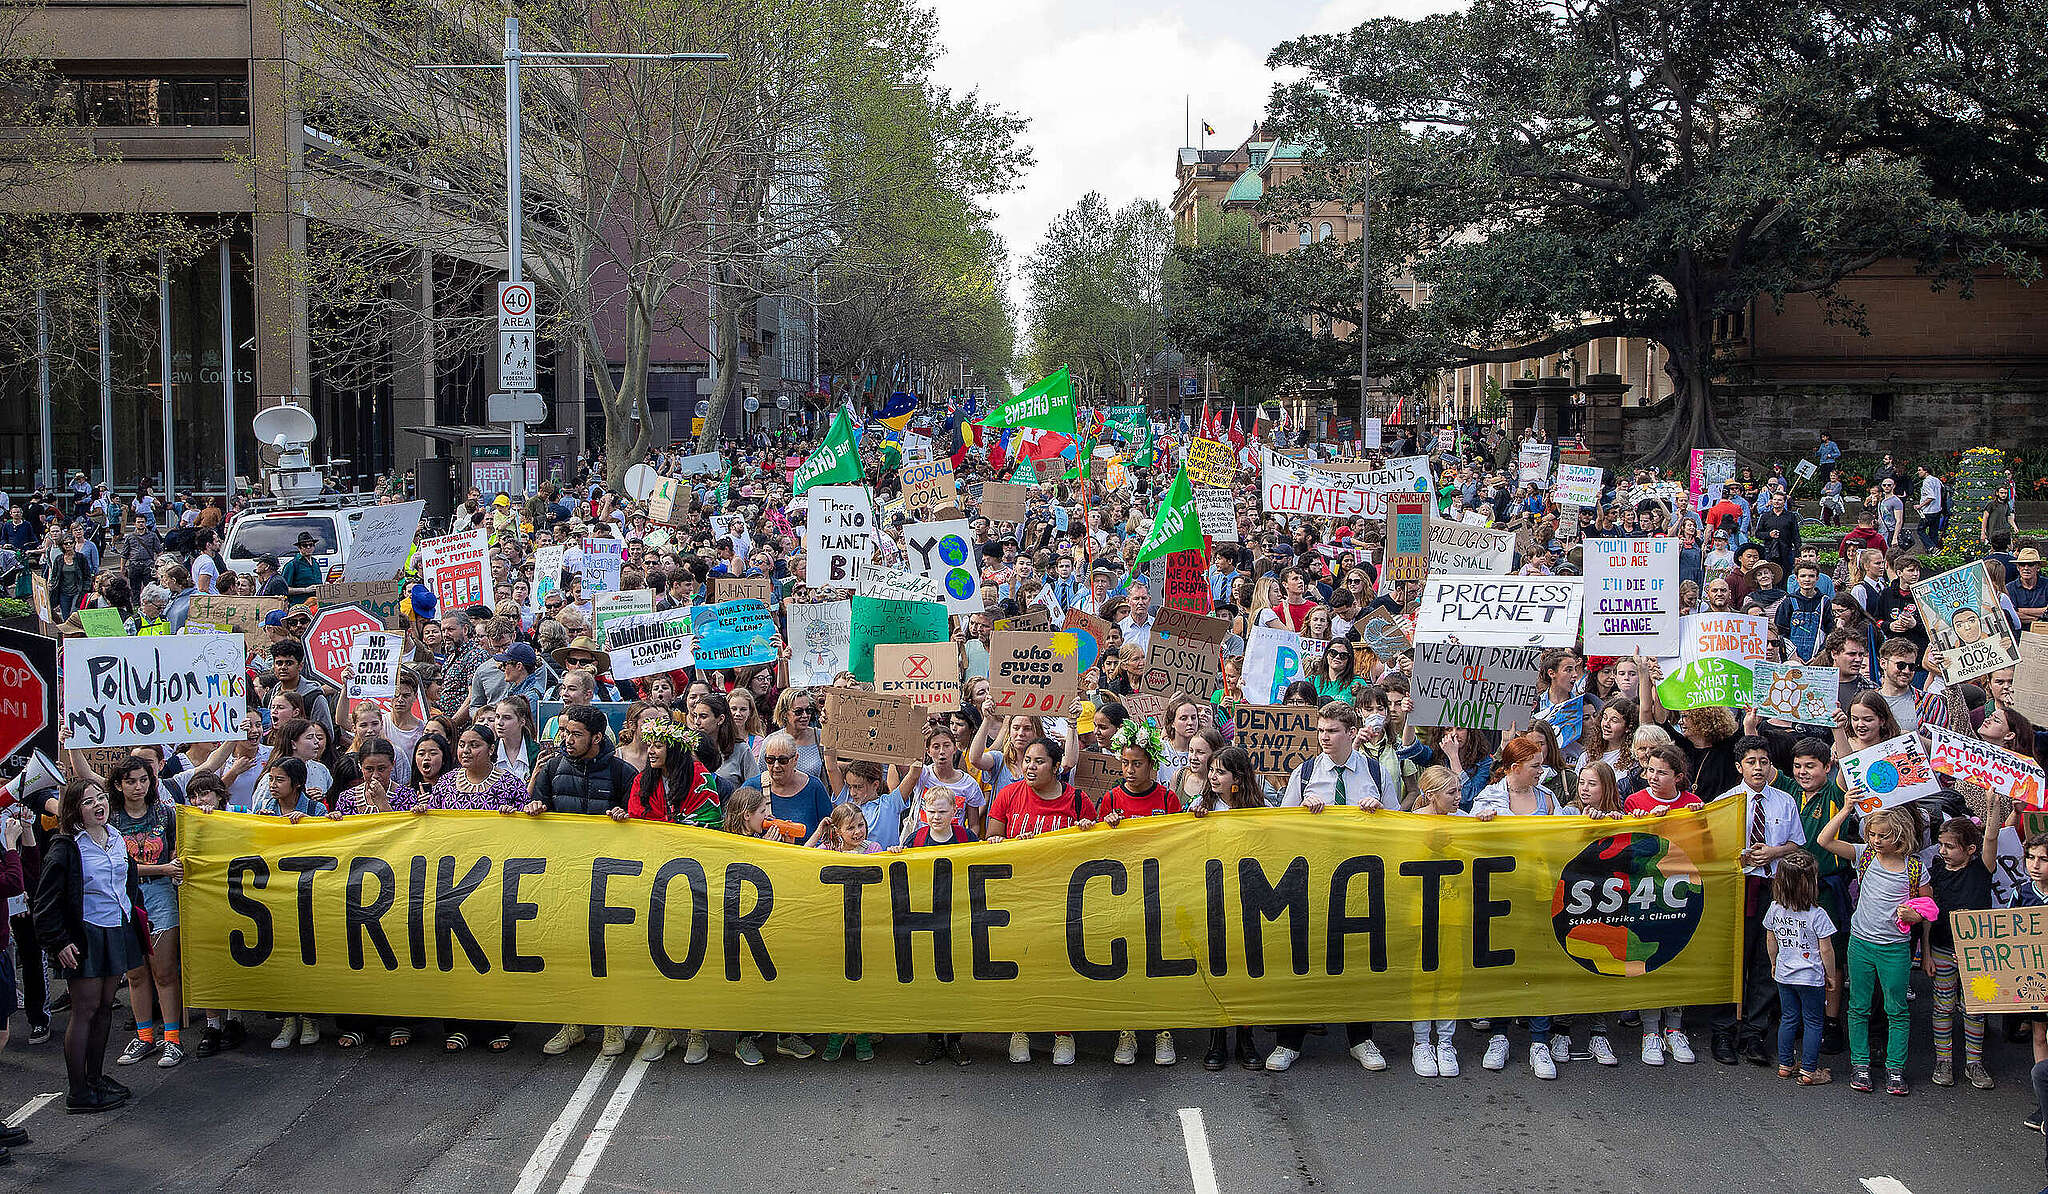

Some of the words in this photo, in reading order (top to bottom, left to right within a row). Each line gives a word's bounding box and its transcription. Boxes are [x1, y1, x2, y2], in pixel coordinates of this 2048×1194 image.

[505, 294, 527, 307] 40
[502, 318, 532, 327] AREA
[475, 468, 505, 480] BEER
[903, 462, 953, 485] CORAL
[1346, 465, 1415, 485] STUDENTS
[1568, 466, 1596, 476] STAND
[915, 480, 937, 490] NOT
[818, 498, 855, 512] There
[910, 487, 949, 507] COAL
[1270, 484, 1348, 515] CLIMATE
[1388, 494, 1398, 502] AS
[1568, 493, 1596, 504] SCIENCE
[840, 512, 865, 527] NO
[441, 531, 478, 544] GAMBLING
[822, 534, 870, 550] PLANET
[434, 545, 456, 554] WITH
[456, 542, 472, 550] OUR
[584, 538, 621, 554] Human
[1634, 542, 1650, 554] DIE
[1654, 541, 1668, 553] OF
[450, 549, 484, 562] FUTURE
[1453, 554, 1492, 571] SMALL
[1609, 556, 1628, 566] OLD
[1630, 556, 1648, 566] AGE
[586, 569, 607, 580] NOT
[863, 566, 886, 582] The
[1932, 572, 1967, 592] REAL
[319, 584, 340, 600] THIS
[348, 584, 358, 597] IS
[366, 582, 393, 597] WHAT
[718, 583, 752, 598] WHAT
[756, 585, 766, 600] I
[1626, 578, 1646, 591] DIE
[1651, 578, 1664, 592] OF
[1935, 582, 1970, 598] CLIMATE
[1437, 583, 1572, 604] PRICELESS
[1941, 590, 1970, 604] ACTION
[876, 600, 930, 615] PLANTS
[1600, 598, 1658, 612] CLIMATE
[886, 616, 912, 624] OVER
[1442, 604, 1566, 623] PLANET
[718, 618, 738, 628] KEEP
[854, 622, 888, 638] POWER
[1014, 619, 1031, 628] THE
[1604, 618, 1652, 632] CHANGE
[1700, 620, 1744, 634] WHAT
[1748, 620, 1758, 637] I
[370, 636, 386, 648] NO
[630, 638, 682, 659] LOADING
[1177, 630, 1200, 648] BE
[1202, 636, 1214, 655] A
[1698, 635, 1740, 654] STAND
[1740, 638, 1764, 654] FOR
[1960, 644, 1971, 654] WE
[1970, 641, 1986, 651] NEED
[362, 649, 390, 661] NEW
[632, 656, 656, 667] PLEASE
[660, 652, 678, 660] WAIT
[696, 644, 753, 660] DOLPHINETLY!
[1012, 645, 1052, 660] who
[1422, 643, 1441, 665] WE
[1490, 649, 1542, 672] DRINK
[1958, 644, 1998, 668] 100%
[358, 662, 388, 674] COAL
[1150, 645, 1214, 676] FOSSIL
[1708, 658, 1724, 673] IS
[1958, 656, 2004, 677] RENEWABLES
[87, 647, 202, 706] Pollution
[1000, 662, 1050, 676] gives
[1052, 662, 1064, 672] a
[1463, 666, 1488, 682] OIL
[354, 676, 368, 685] OR
[370, 675, 388, 685] GAS
[882, 681, 958, 690] EXTINCTION
[1012, 674, 1052, 688] crap
[1174, 672, 1211, 700] FOOL
[1694, 674, 1729, 692] WHAT
[1732, 677, 1739, 688] I
[996, 690, 1016, 706] I
[1023, 692, 1065, 712] DO!
[1481, 682, 1537, 706] BREATHE
[1686, 689, 1726, 707] STAND
[1734, 690, 1752, 704] ON
[1236, 709, 1318, 732] DENIAL
[1438, 699, 1504, 730] MONEY
[1237, 732, 1258, 748] IS
[1261, 732, 1296, 751] NOT
[1298, 738, 1309, 752] A
[1249, 751, 1315, 772] OLICY
[1936, 744, 1988, 766] ACTION
[1992, 762, 2025, 780] NOW
[1938, 734, 1951, 744] IS
[1962, 742, 2046, 779] HAPPENING
[1896, 760, 1912, 775] NO
[1954, 760, 2005, 785] SCOMO
[1858, 796, 1883, 814] B
[1566, 874, 1690, 914] SS4C
[227, 855, 547, 975] STRIKE
[589, 857, 778, 983] FOR
[819, 857, 1019, 983] THE
[1066, 855, 1518, 980] CLIMATE
[1568, 917, 1602, 926] School
[1606, 916, 1634, 924] Strike
[1650, 912, 1686, 920] Climate
[1771, 916, 1794, 926] MAKE
[1795, 920, 1807, 928] THE
[1955, 913, 2042, 940] WHERE
[1964, 944, 2046, 972] EARTH
